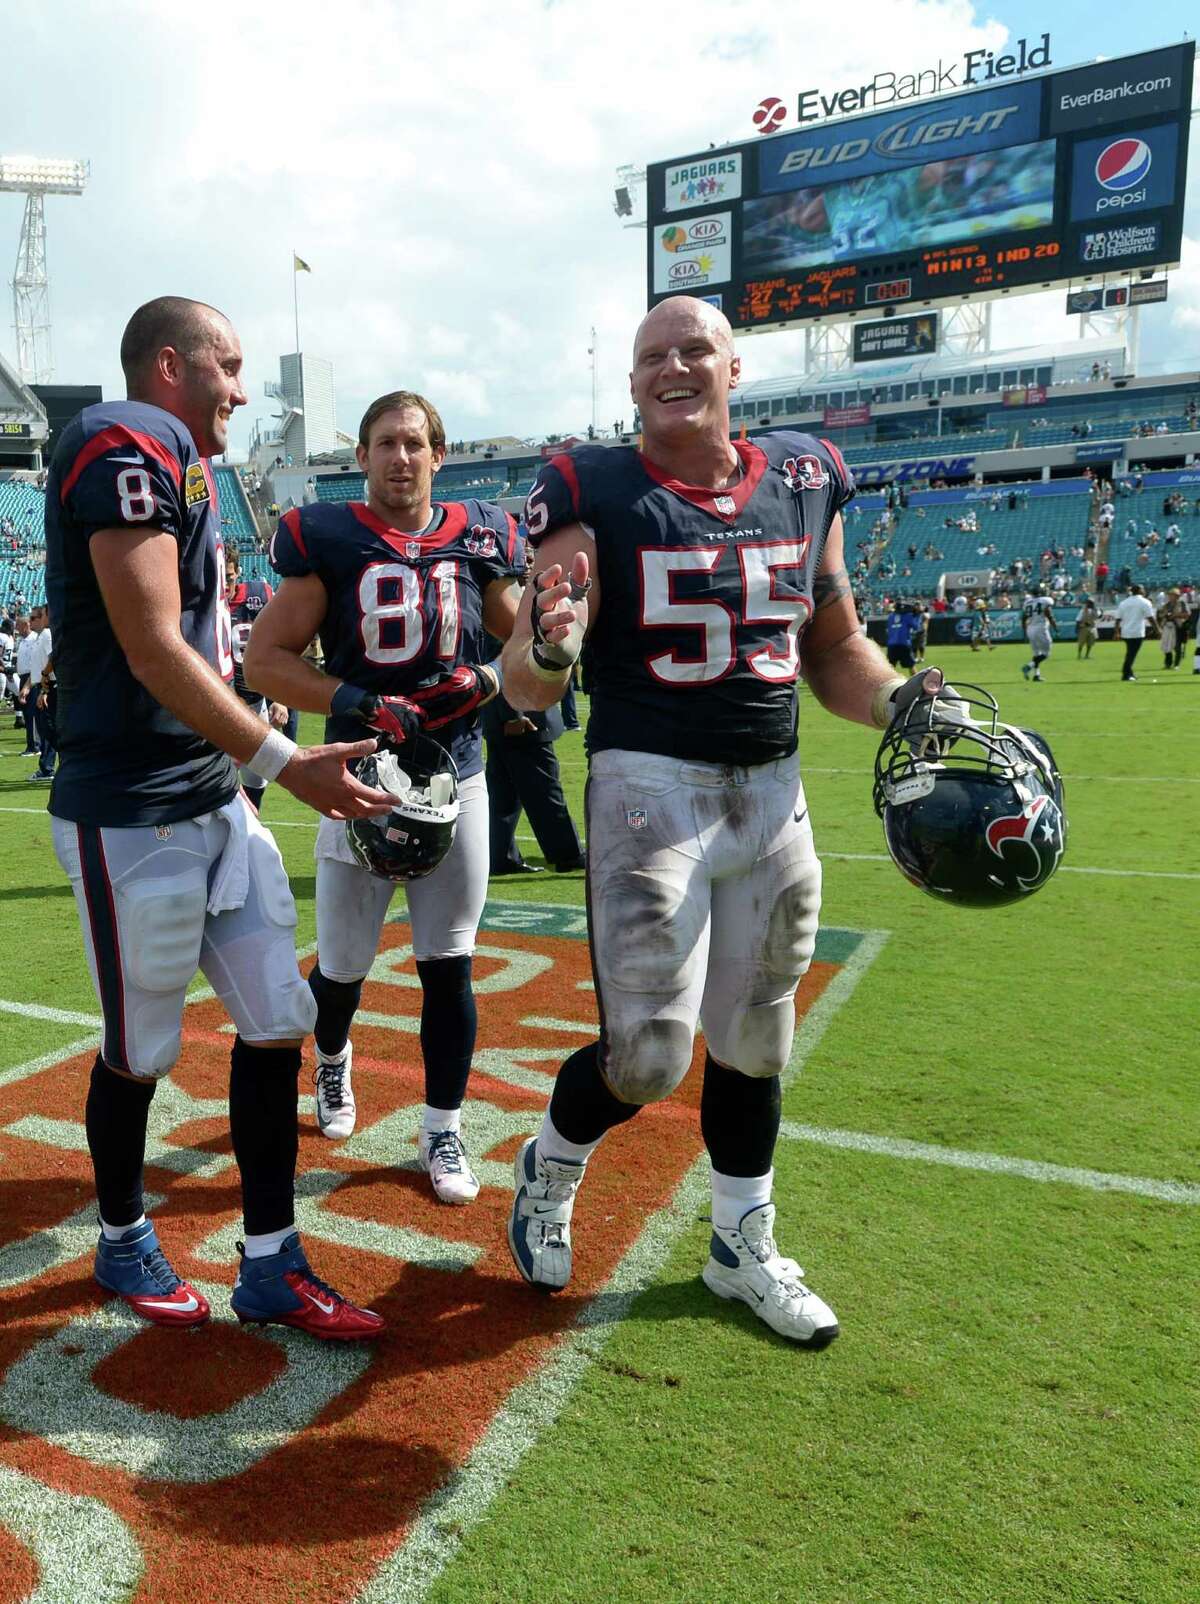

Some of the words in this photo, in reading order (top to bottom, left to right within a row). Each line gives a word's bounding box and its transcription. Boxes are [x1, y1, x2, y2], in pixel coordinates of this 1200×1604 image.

[797, 58, 959, 123] EverBank
[962, 32, 1052, 85] Field
[1060, 76, 1171, 110] EverBank.com
[778, 138, 870, 174] BUD
[888, 106, 1018, 150] LIGHT
[671, 159, 735, 186] JAGUARS
[1096, 188, 1146, 212] pepsi
[694, 222, 718, 237] KIA
[1108, 226, 1155, 241] Wolfson
[1034, 242, 1060, 258] 20
[674, 263, 697, 277] KIA
[806, 266, 857, 282] JAGUARS
[750, 288, 774, 305] 27
[861, 325, 909, 341] JAGUARS
[894, 457, 975, 480] ZONE
[116, 467, 156, 522] 8
[704, 529, 762, 541] TEXANS
[356, 560, 461, 666] 81
[637, 535, 813, 687] 55
[402, 806, 446, 820] TEXANS
